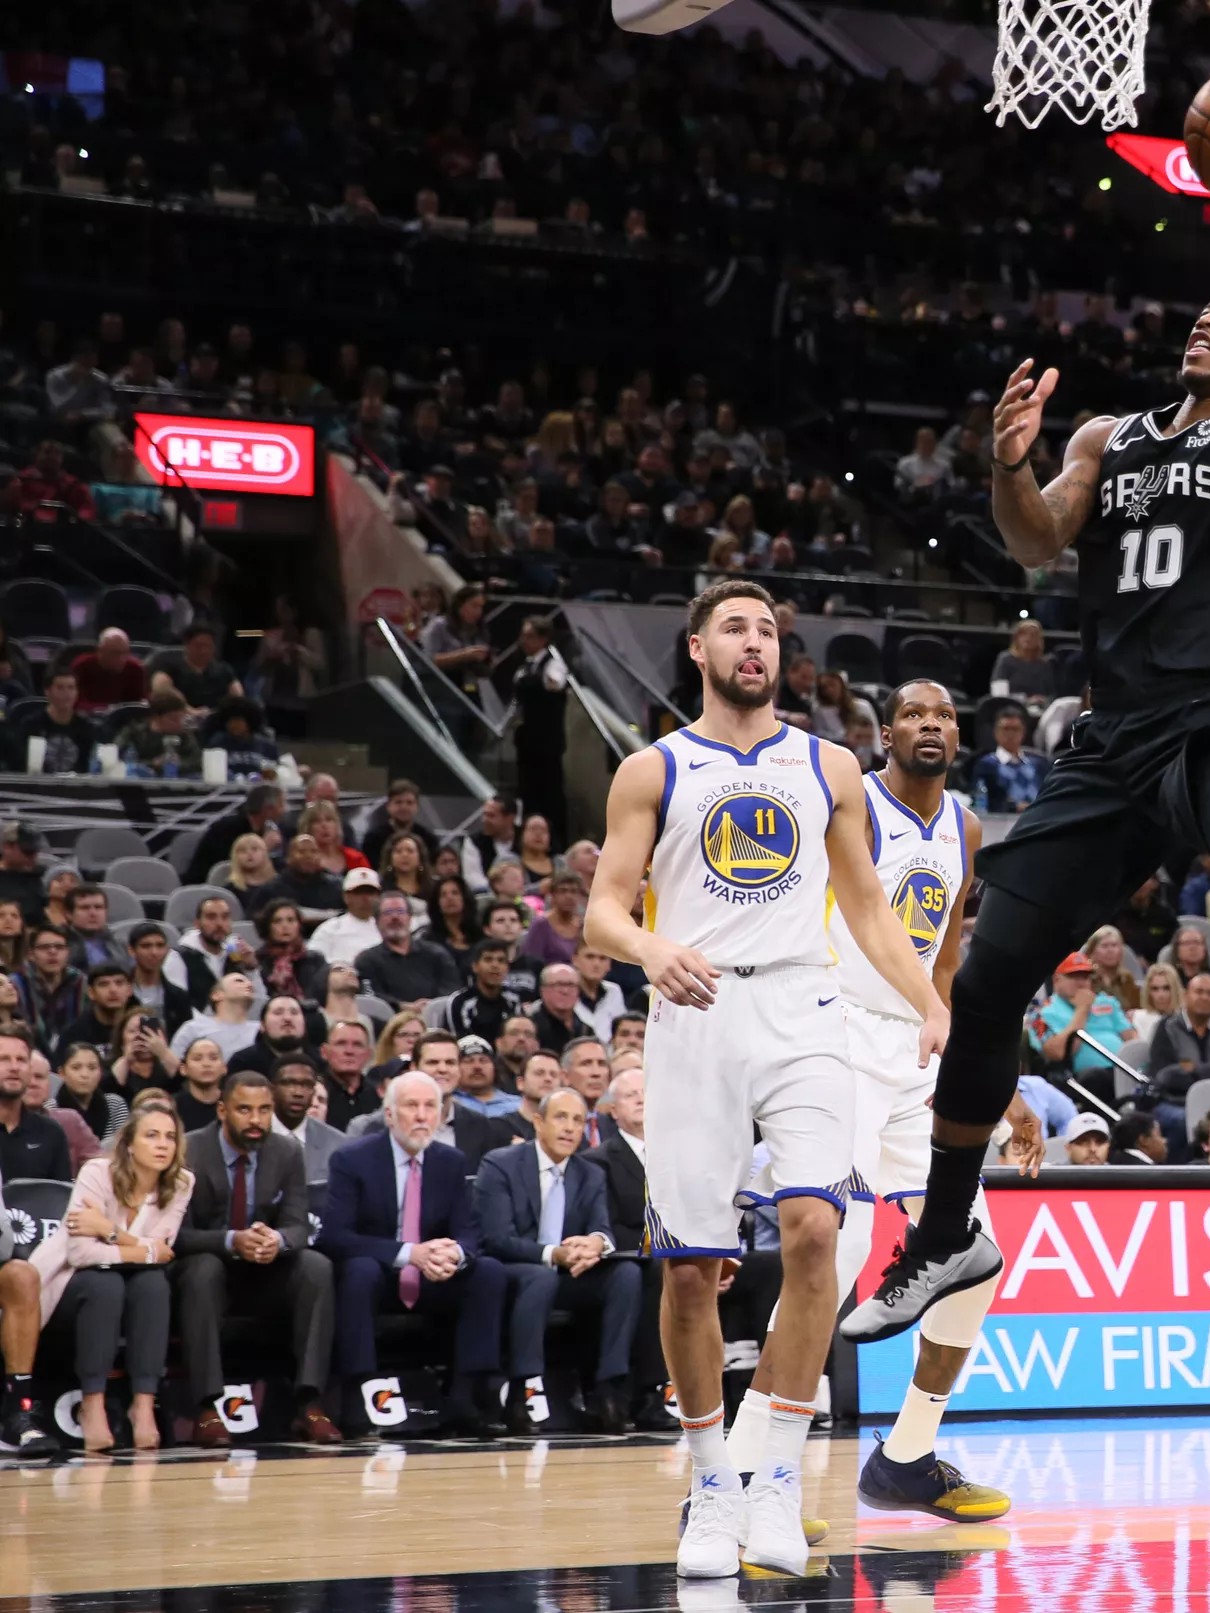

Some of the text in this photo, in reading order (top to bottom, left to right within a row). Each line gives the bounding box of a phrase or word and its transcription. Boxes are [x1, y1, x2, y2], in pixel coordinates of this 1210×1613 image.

[1117, 524, 1184, 593] 10
[769, 757, 807, 766] Rakuten
[697, 782, 802, 812] GOLDEN STATE
[754, 808, 776, 835] 11
[703, 870, 802, 905] WARRIORS
[894, 858, 953, 888] GOLDEN STATE
[921, 886, 944, 912] 35
[912, 1327, 1079, 1394] AW
